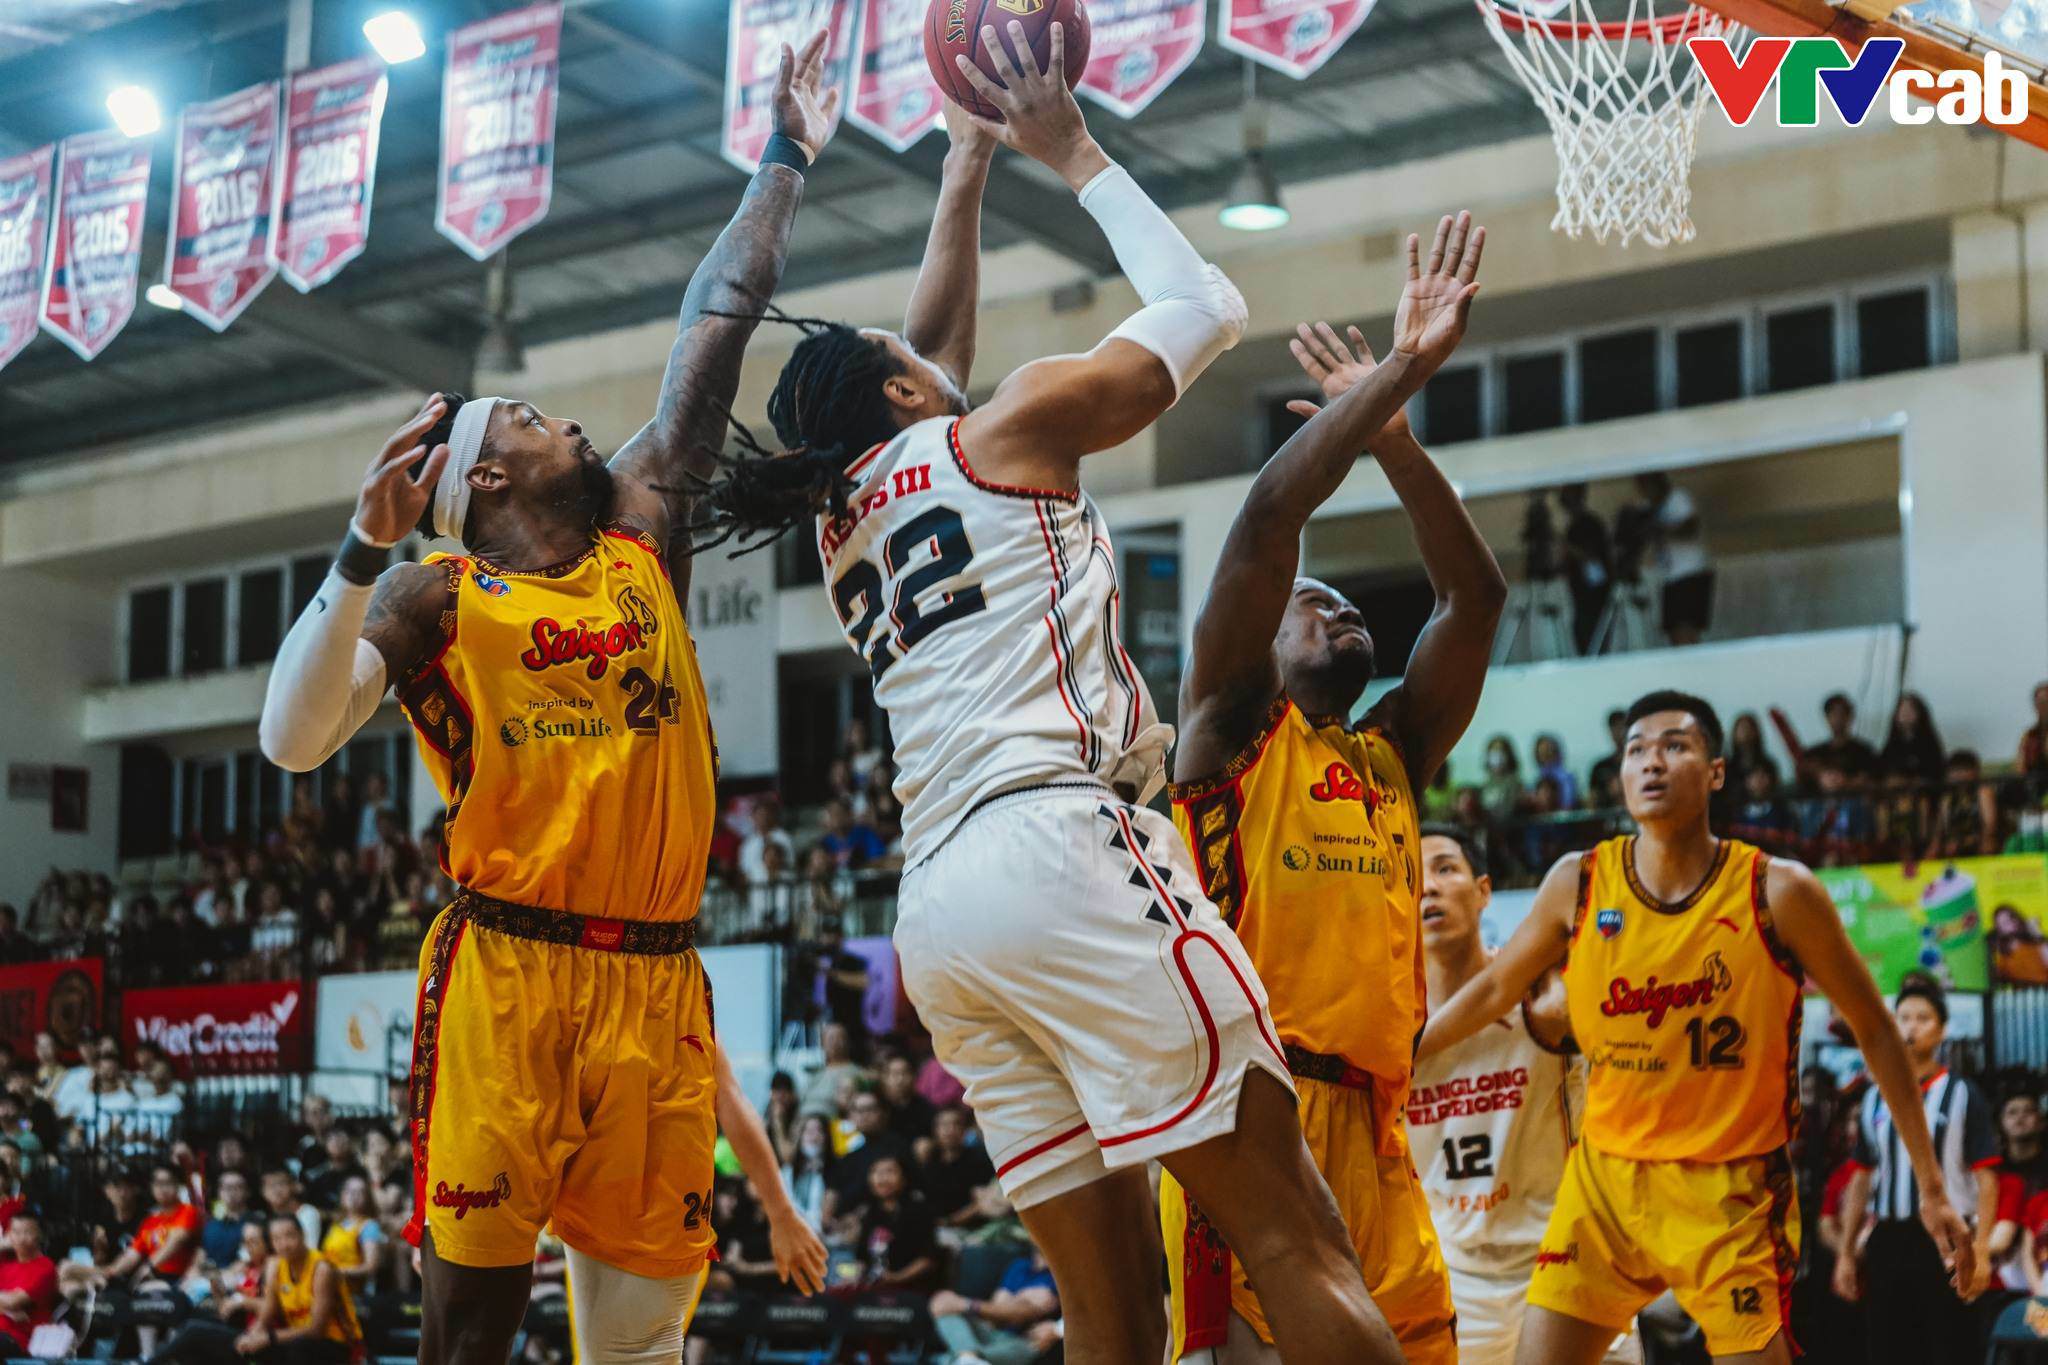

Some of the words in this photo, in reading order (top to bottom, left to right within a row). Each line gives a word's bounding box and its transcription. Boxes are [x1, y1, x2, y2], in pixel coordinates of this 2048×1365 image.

[893, 463, 932, 499] III
[831, 503, 988, 690] 22
[520, 616, 648, 681] Saigon
[528, 697, 577, 711] inspired
[579, 697, 594, 710] by
[533, 719, 577, 739] Sun
[1314, 832, 1361, 846] inspired
[1363, 833, 1378, 848] by
[1316, 853, 1353, 873] Sun
[1600, 975, 1715, 1030] Saigon
[1685, 1014, 1747, 1070] 12
[1407, 1067, 1529, 1106] HANGLONG
[1441, 1133, 1494, 1181] 12
[432, 1181, 501, 1220] Saigon
[683, 1188, 712, 1232] 24
[1729, 1286, 1763, 1316] 12
